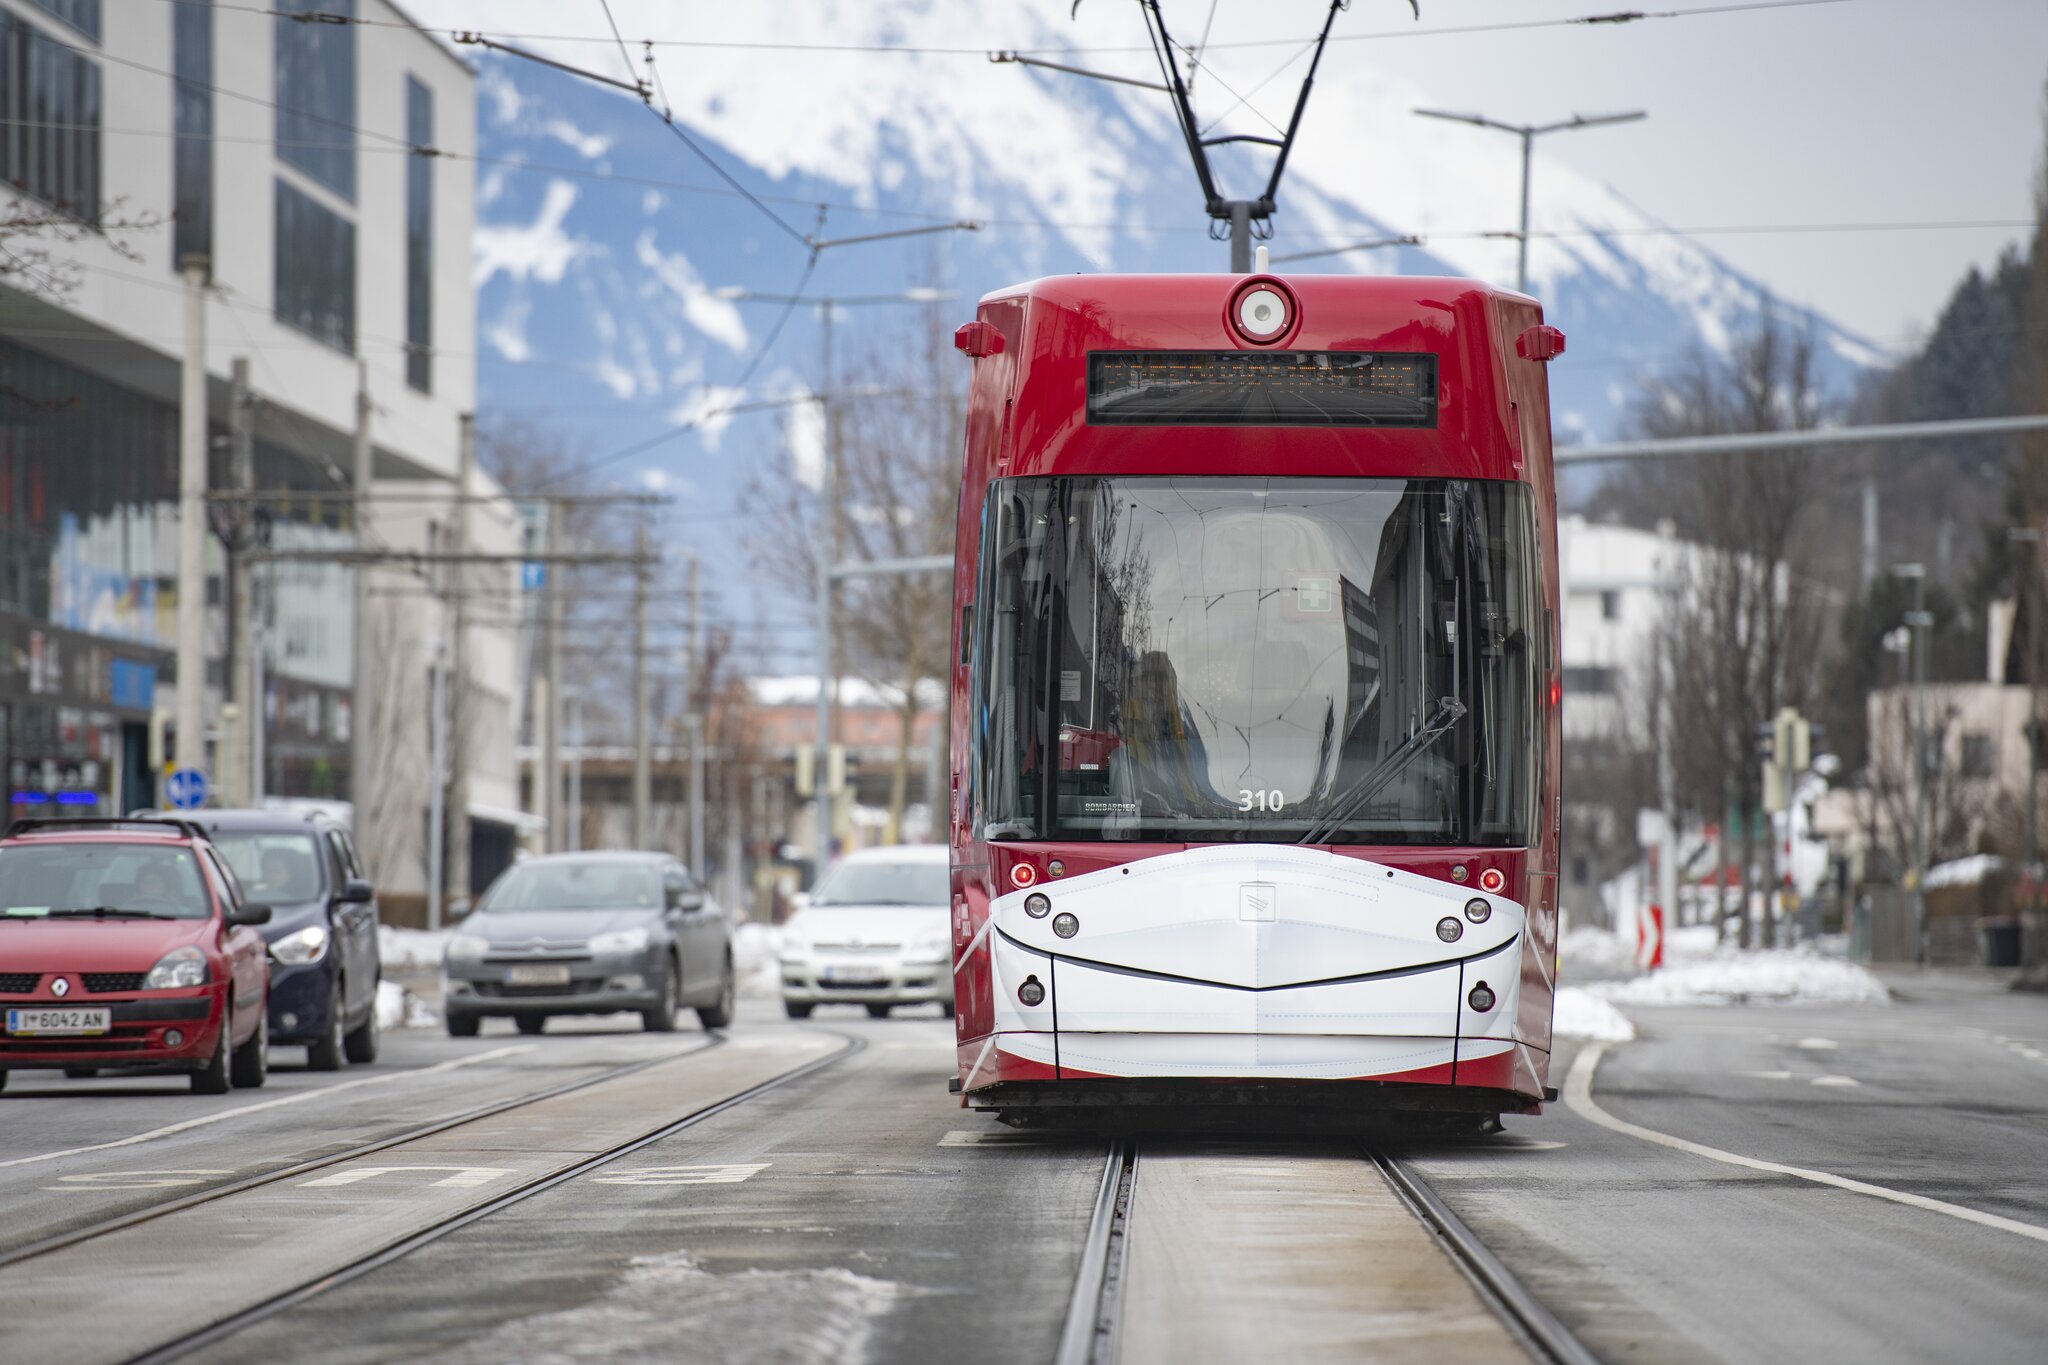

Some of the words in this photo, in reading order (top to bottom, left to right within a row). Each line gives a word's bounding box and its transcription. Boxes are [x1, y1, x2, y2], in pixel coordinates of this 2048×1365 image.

[1085, 803, 1136, 812] BOMBARDIER
[1239, 790, 1284, 812] 310
[40, 1013, 80, 1027] 6042
[83, 1012, 104, 1027] AN
[40, 1164, 772, 1190] BUS
